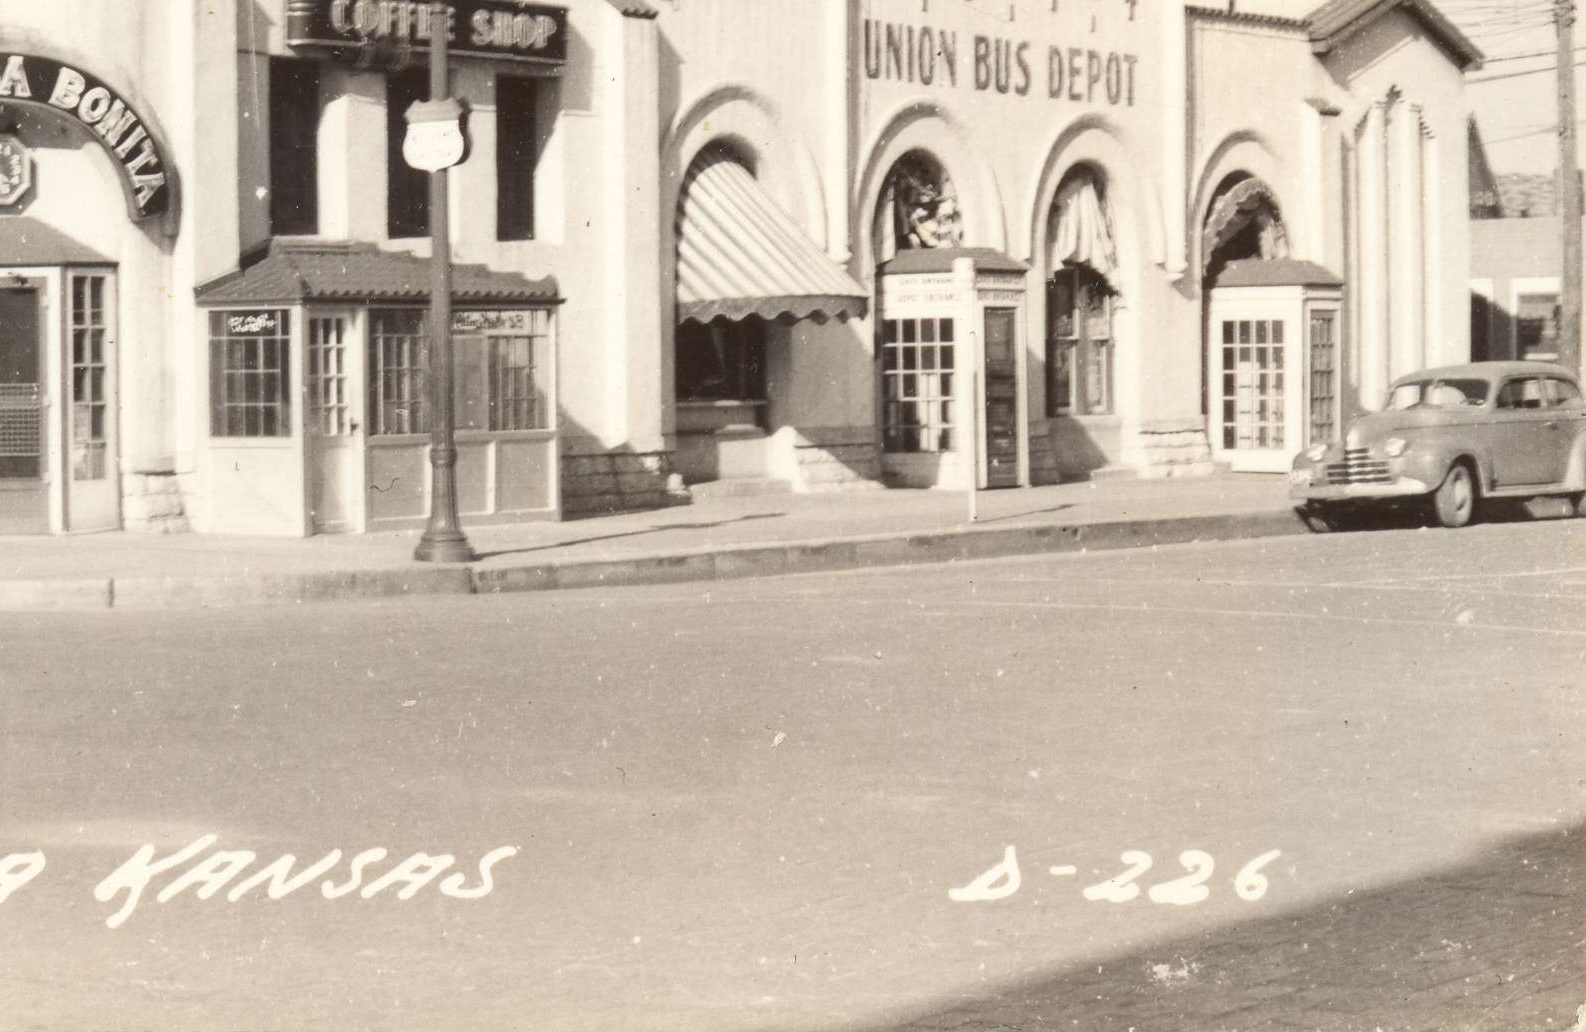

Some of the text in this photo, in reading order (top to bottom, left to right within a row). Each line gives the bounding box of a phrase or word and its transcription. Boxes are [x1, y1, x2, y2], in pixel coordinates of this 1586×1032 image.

[471, 9, 558, 49] SHOP
[864, 18, 1139, 107] UNION BUS DEPOT
[48, 66, 166, 217] BONITA
